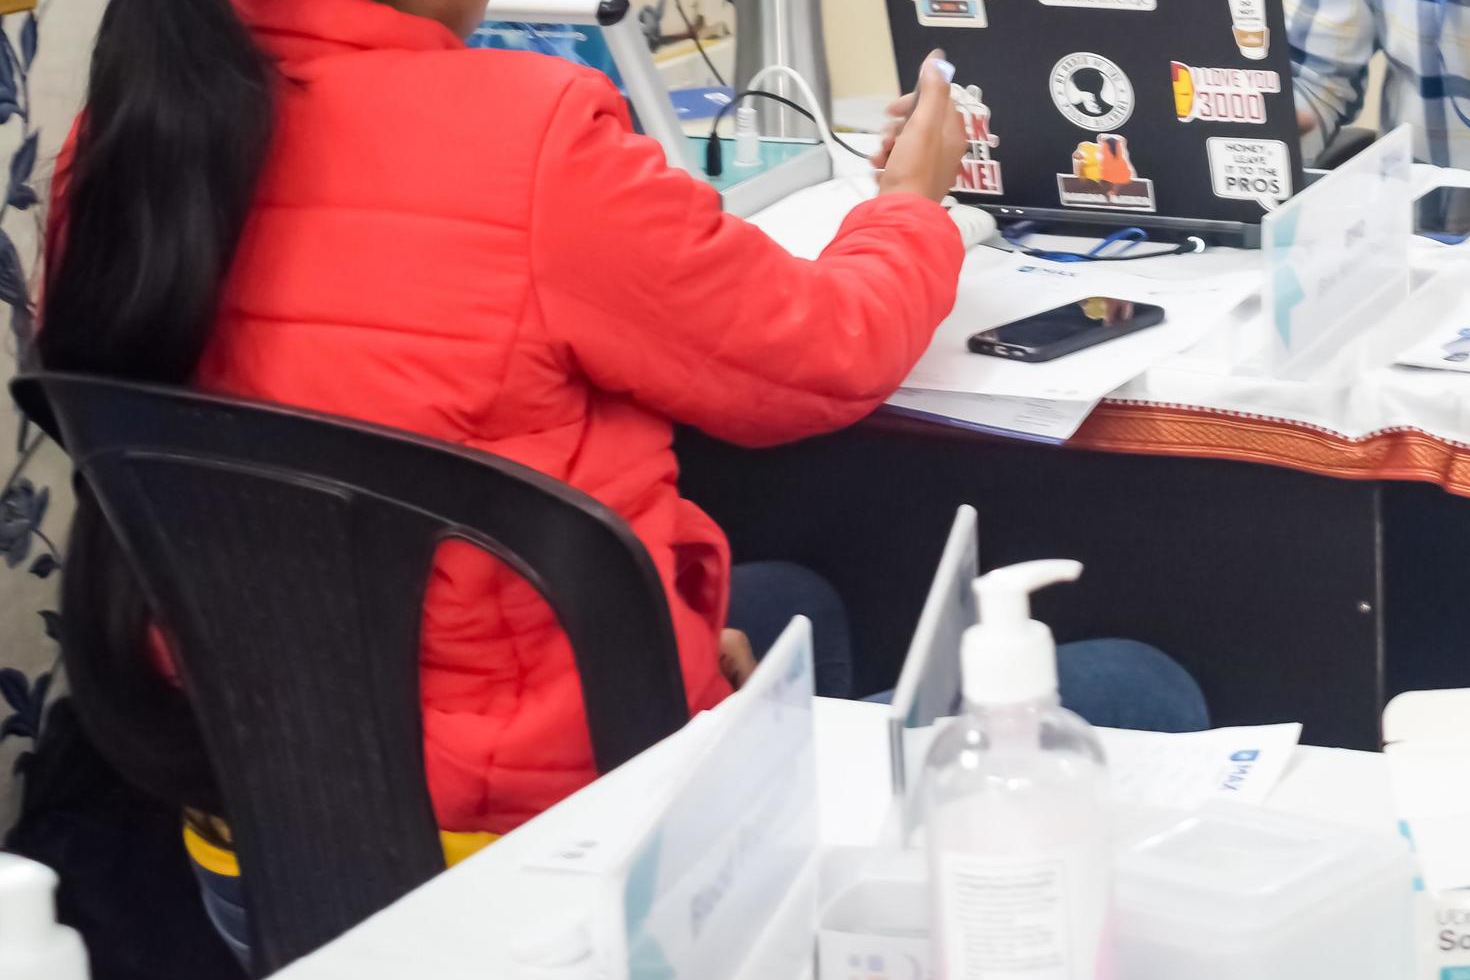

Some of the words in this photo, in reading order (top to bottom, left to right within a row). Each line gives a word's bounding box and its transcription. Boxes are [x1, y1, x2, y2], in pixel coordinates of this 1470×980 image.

[1203, 69, 1241, 88] LOVE
[1242, 70, 1277, 90] YOU
[1198, 90, 1264, 121] 3000
[1227, 176, 1281, 194] PROS
